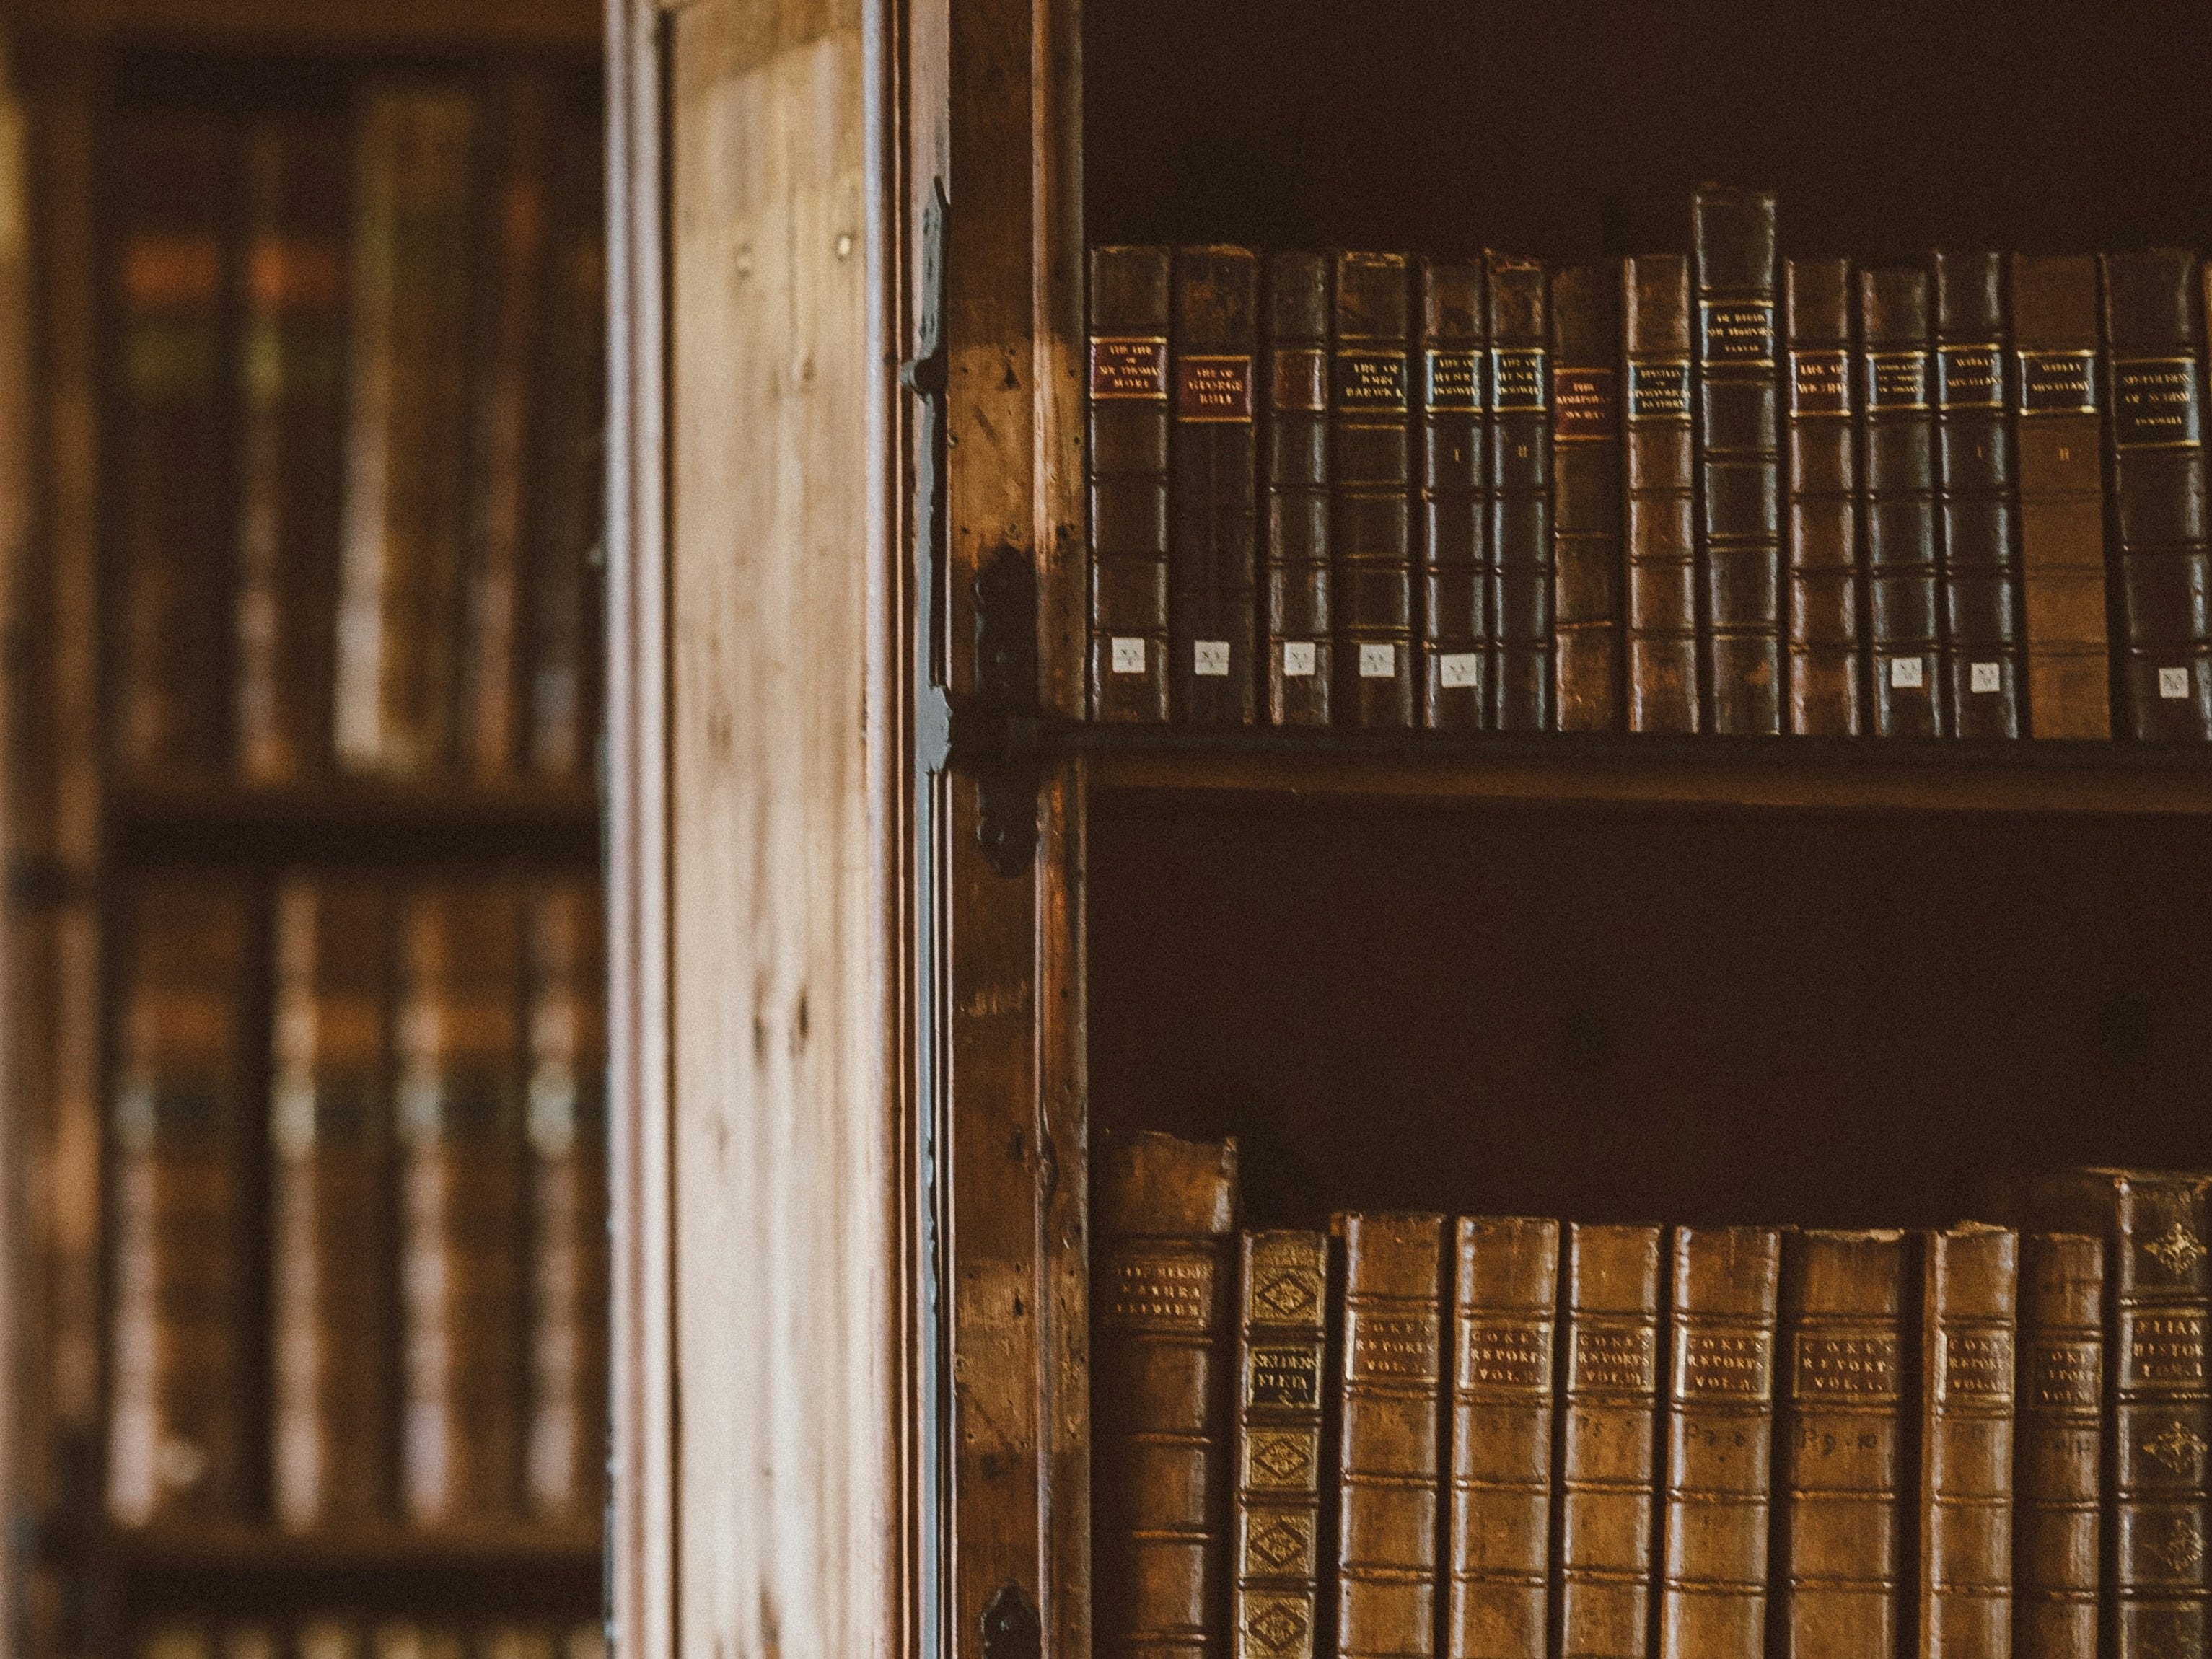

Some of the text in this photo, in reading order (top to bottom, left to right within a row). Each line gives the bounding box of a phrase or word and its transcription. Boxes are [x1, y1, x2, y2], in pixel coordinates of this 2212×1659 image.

[1114, 377, 1149, 387] MORE
[1188, 379, 1243, 392] GEORGE
[1356, 1339, 1434, 1354] REPORTS
[1470, 1347, 1547, 1363] REPORTS
[1578, 1351, 1649, 1367] REPORTS
[1366, 1360, 1406, 1372] VOL.
[1687, 1355, 1763, 1370] REPORTS
[1803, 1357, 1895, 1373] REPORTS
[1478, 1368, 1520, 1382] VOL.
[1586, 1370, 1624, 1384] VOL.
[1695, 1376, 1735, 1389] VOL.
[1814, 1376, 1858, 1390] VOL.
[1953, 1378, 1989, 1389] VOL.
